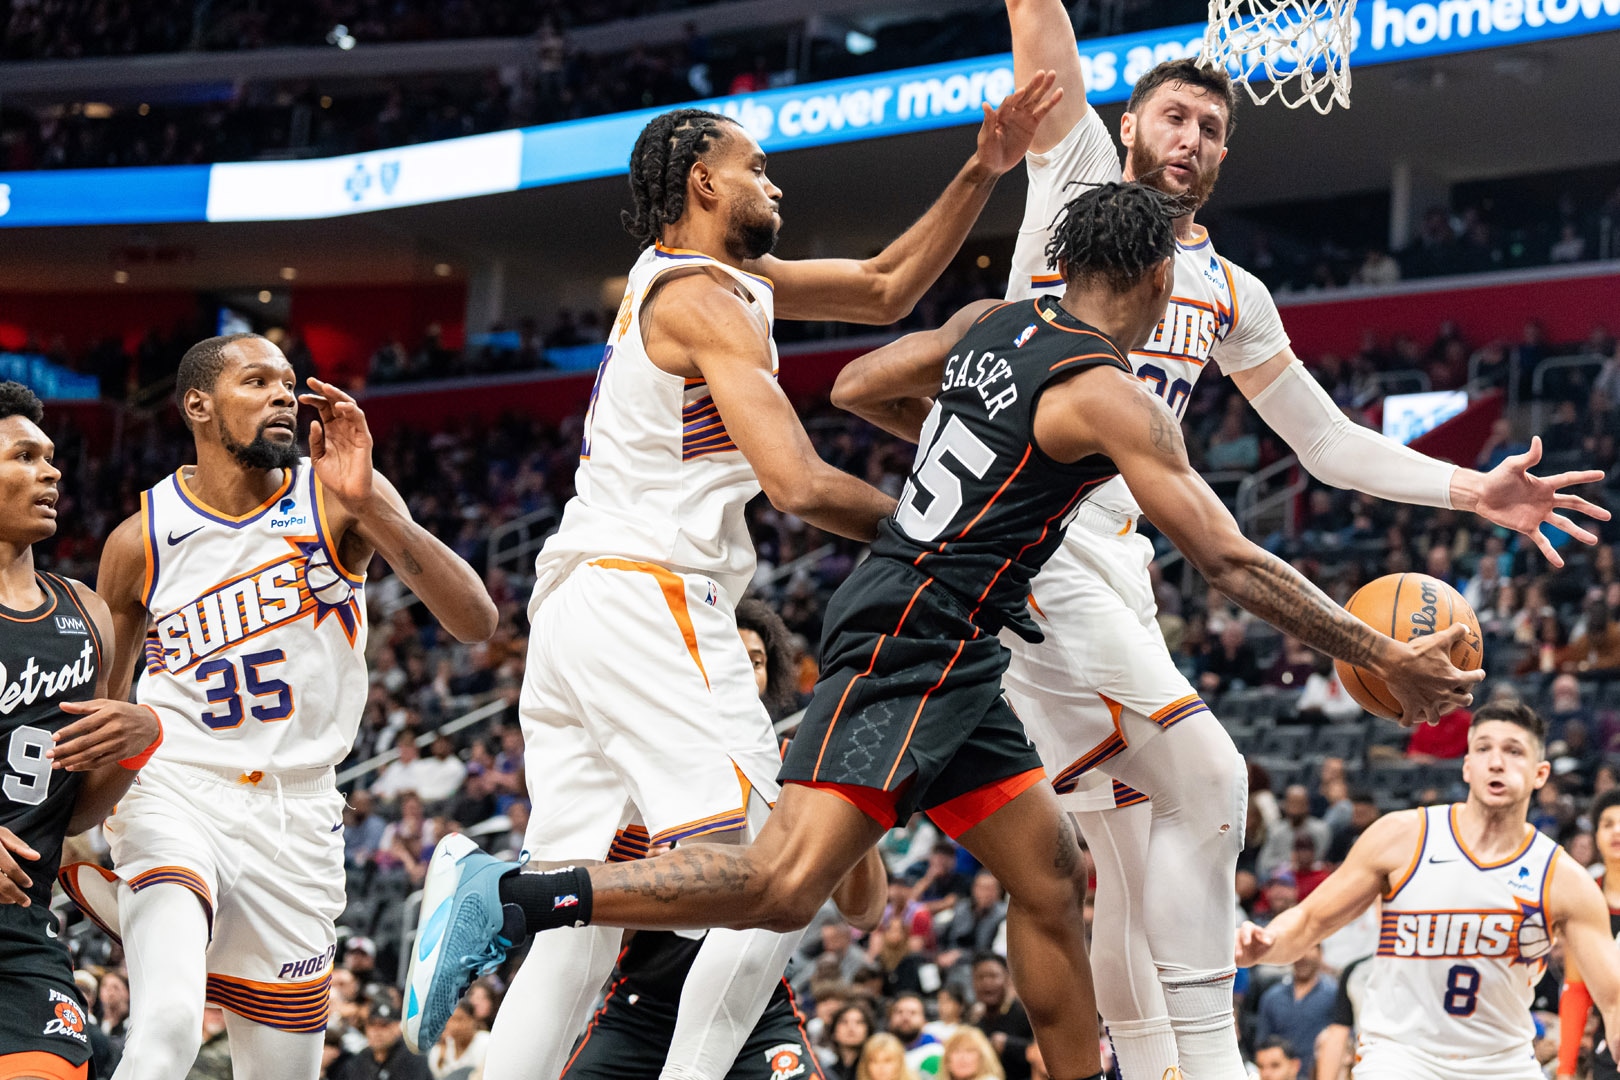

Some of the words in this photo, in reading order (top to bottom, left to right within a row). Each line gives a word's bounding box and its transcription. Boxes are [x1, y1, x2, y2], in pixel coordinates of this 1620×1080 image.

[778, 86, 893, 137] cover
[897, 68, 1014, 120] more
[1144, 302, 1216, 361] UNS
[271, 516, 306, 528] PayPal
[55, 617, 86, 631] UWM
[157, 561, 301, 674] SUNS
[1408, 581, 1438, 641] ilson
[195, 648, 295, 731] 35
[2, 725, 57, 806] 9
[1394, 913, 1515, 957] SUNS
[1443, 964, 1483, 1018] 8
